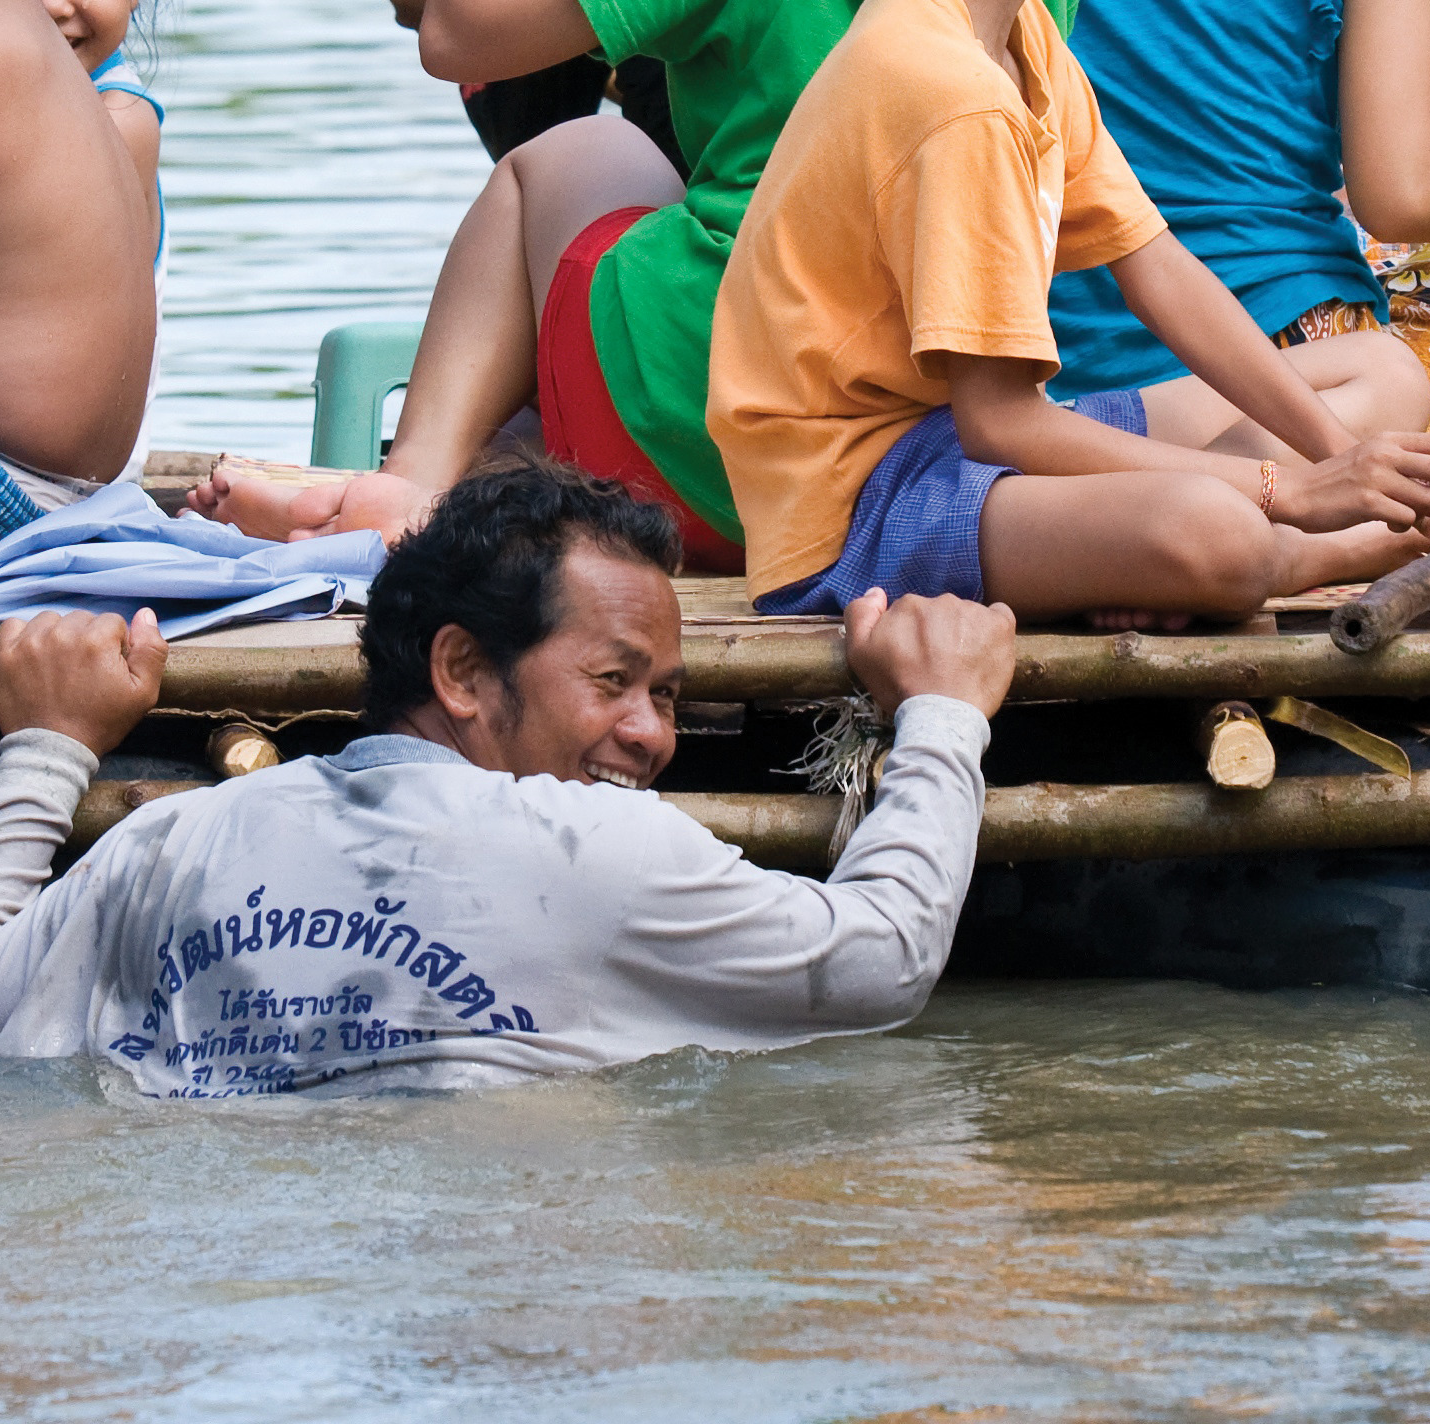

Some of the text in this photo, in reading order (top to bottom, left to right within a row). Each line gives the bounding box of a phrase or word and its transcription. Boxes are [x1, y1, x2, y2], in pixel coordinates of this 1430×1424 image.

[219, 984, 373, 1021] ได้รับรางวัล
[165, 1025, 300, 1068] หอพักดีเด่น
[309, 1027, 327, 1052] 2
